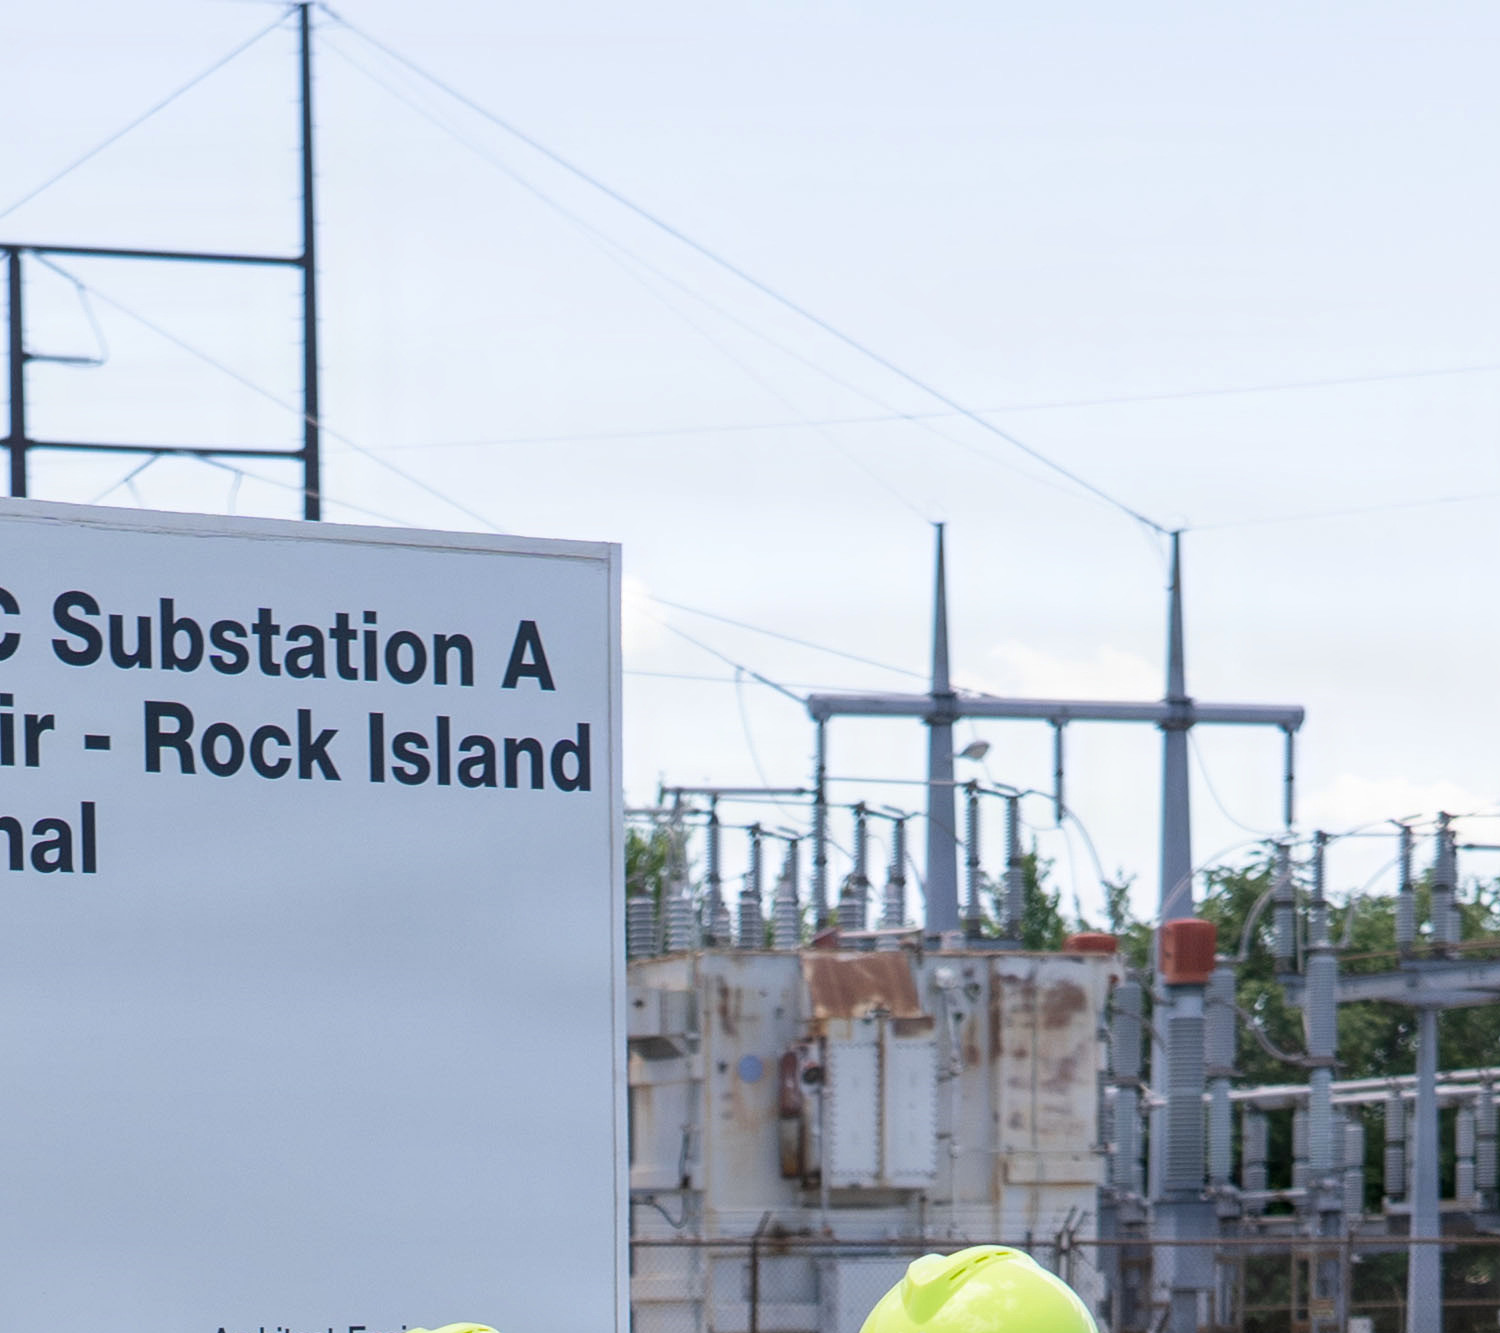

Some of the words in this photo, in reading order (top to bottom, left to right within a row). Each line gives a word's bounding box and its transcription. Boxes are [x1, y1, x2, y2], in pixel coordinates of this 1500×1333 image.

[51, 590, 474, 687] Substation
[501, 619, 556, 691] A
[143, 699, 342, 781] Rock
[368, 712, 592, 792] Island
